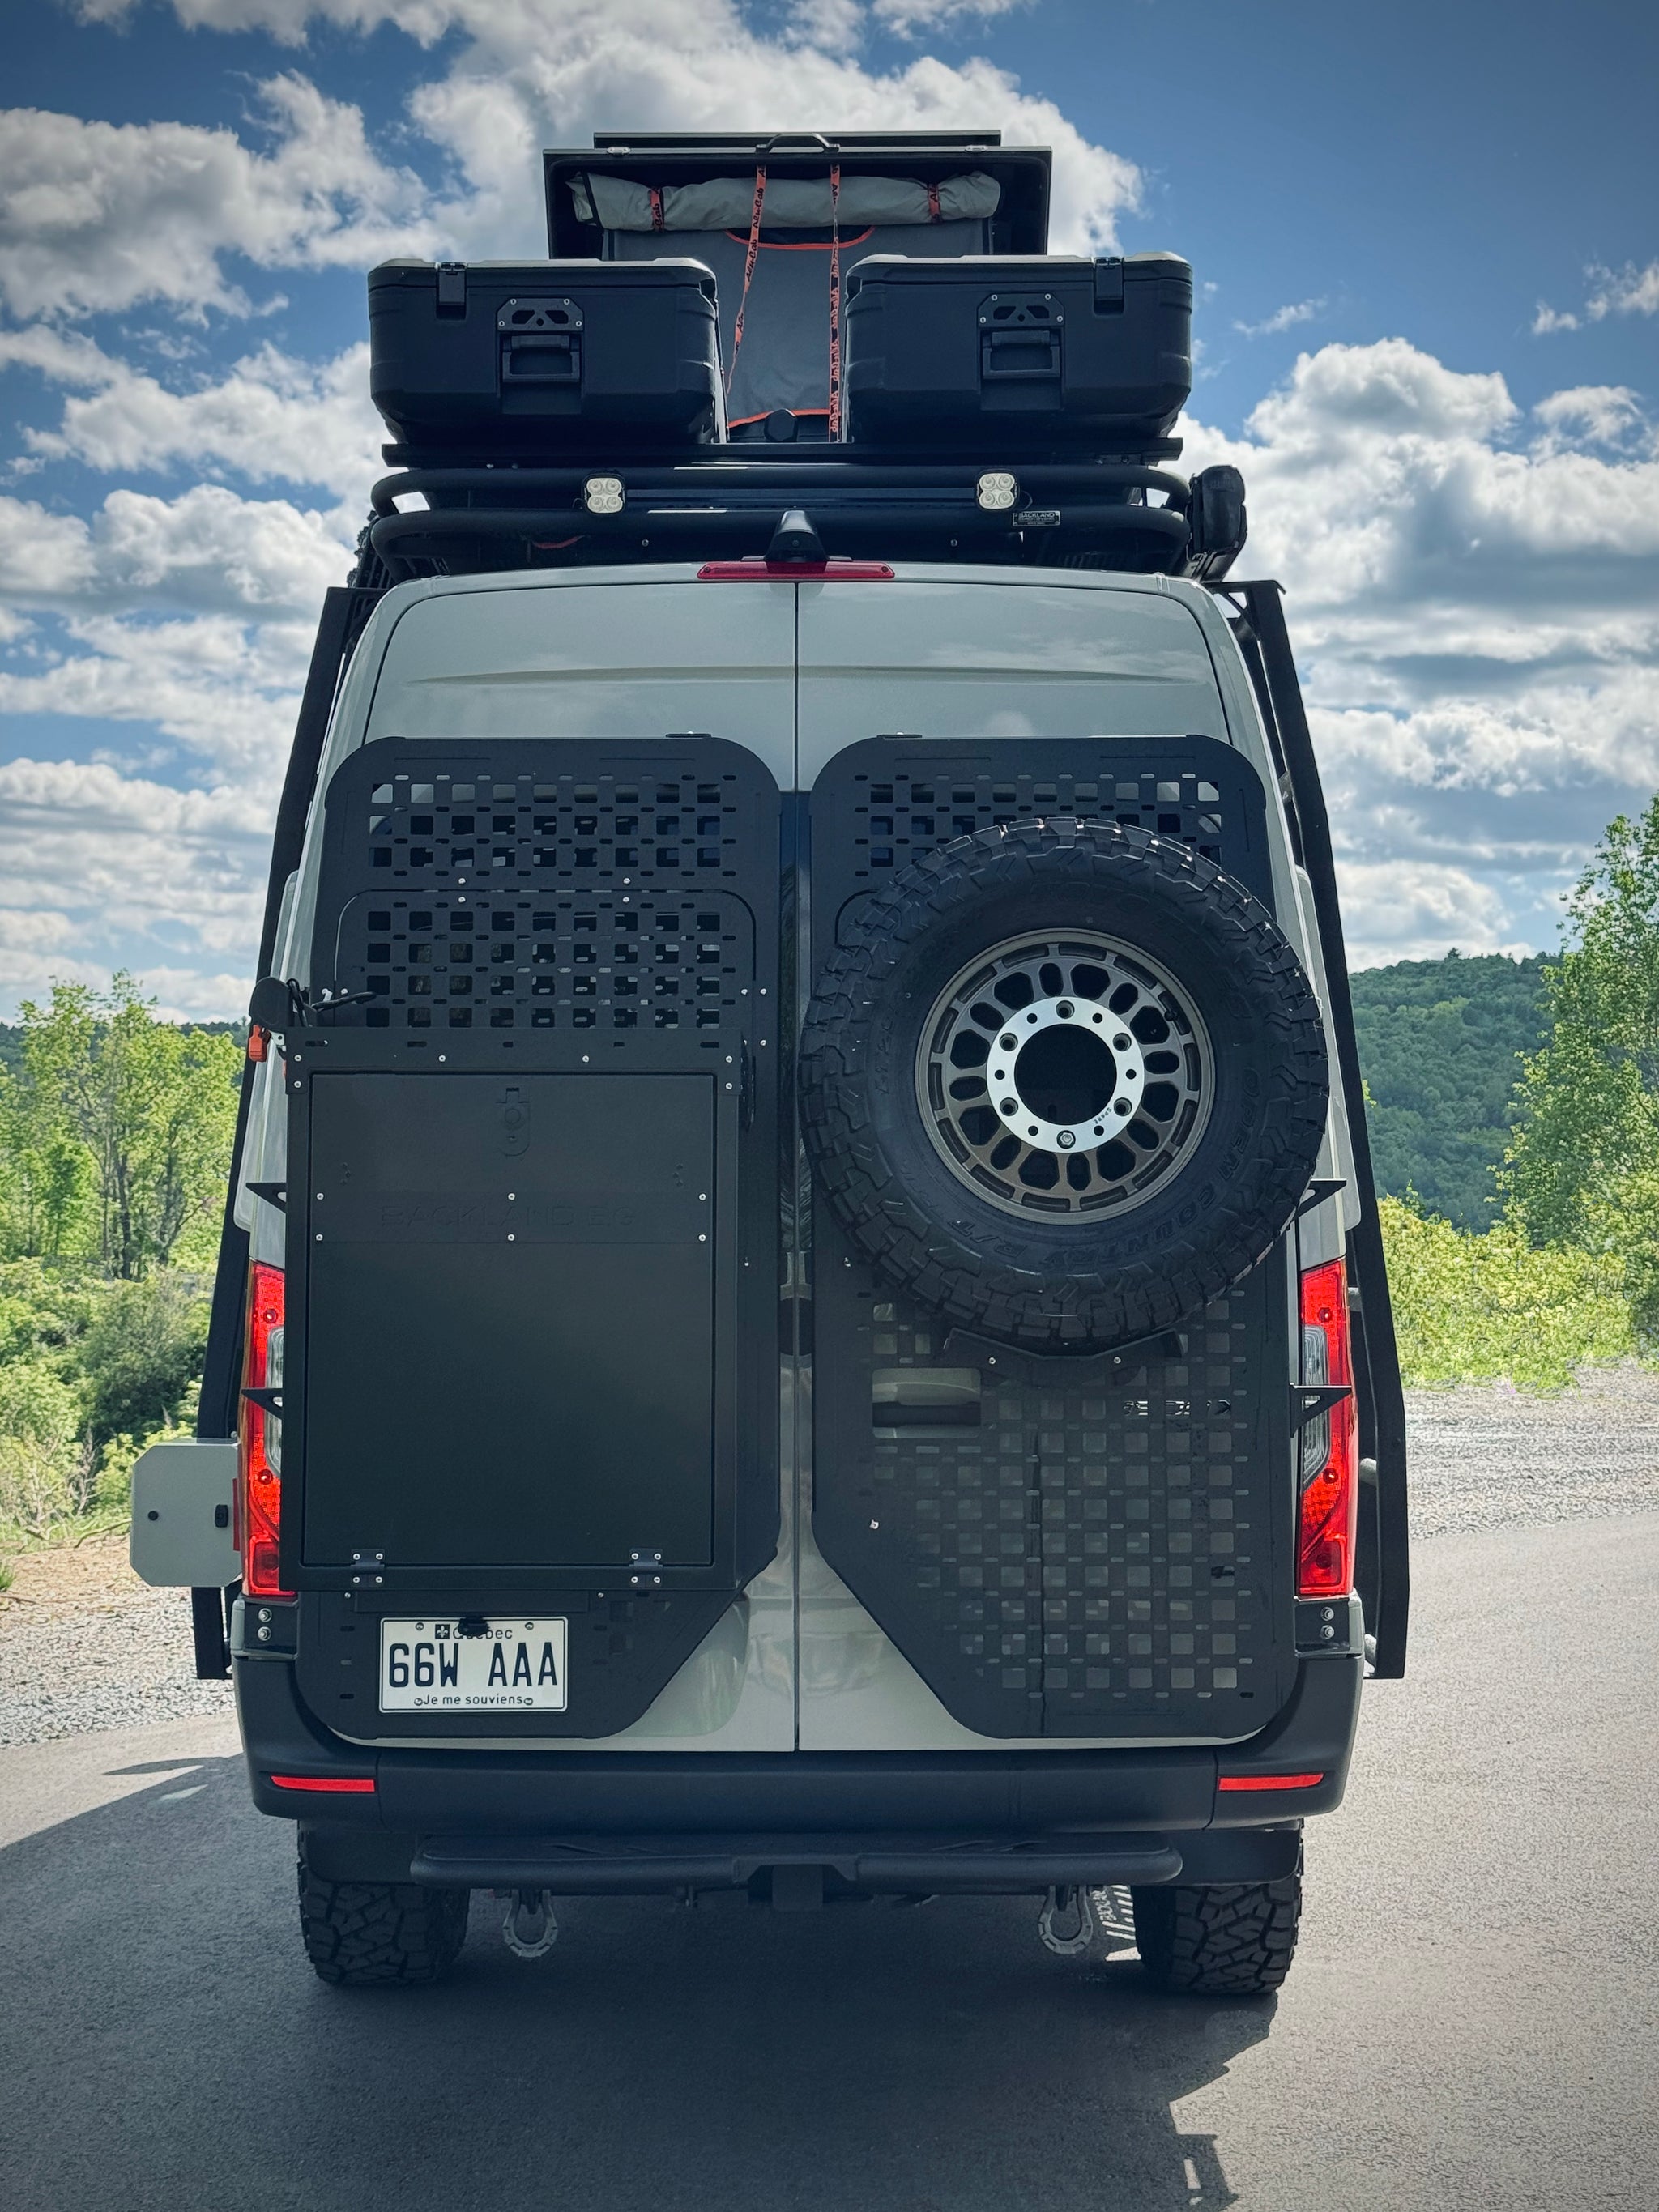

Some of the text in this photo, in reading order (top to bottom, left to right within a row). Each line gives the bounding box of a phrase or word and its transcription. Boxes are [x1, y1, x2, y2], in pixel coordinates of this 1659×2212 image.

[752, 187, 764, 229] Alu-Cab
[746, 239, 758, 282] Alu-Cab
[1213, 1066, 1261, 1183] OPEN
[1039, 1178, 1222, 1269] COUNTRY
[389, 1642, 557, 1688] 66W AAA
[423, 1694, 438, 1705] Je
[465, 1694, 522, 1704] souviens
